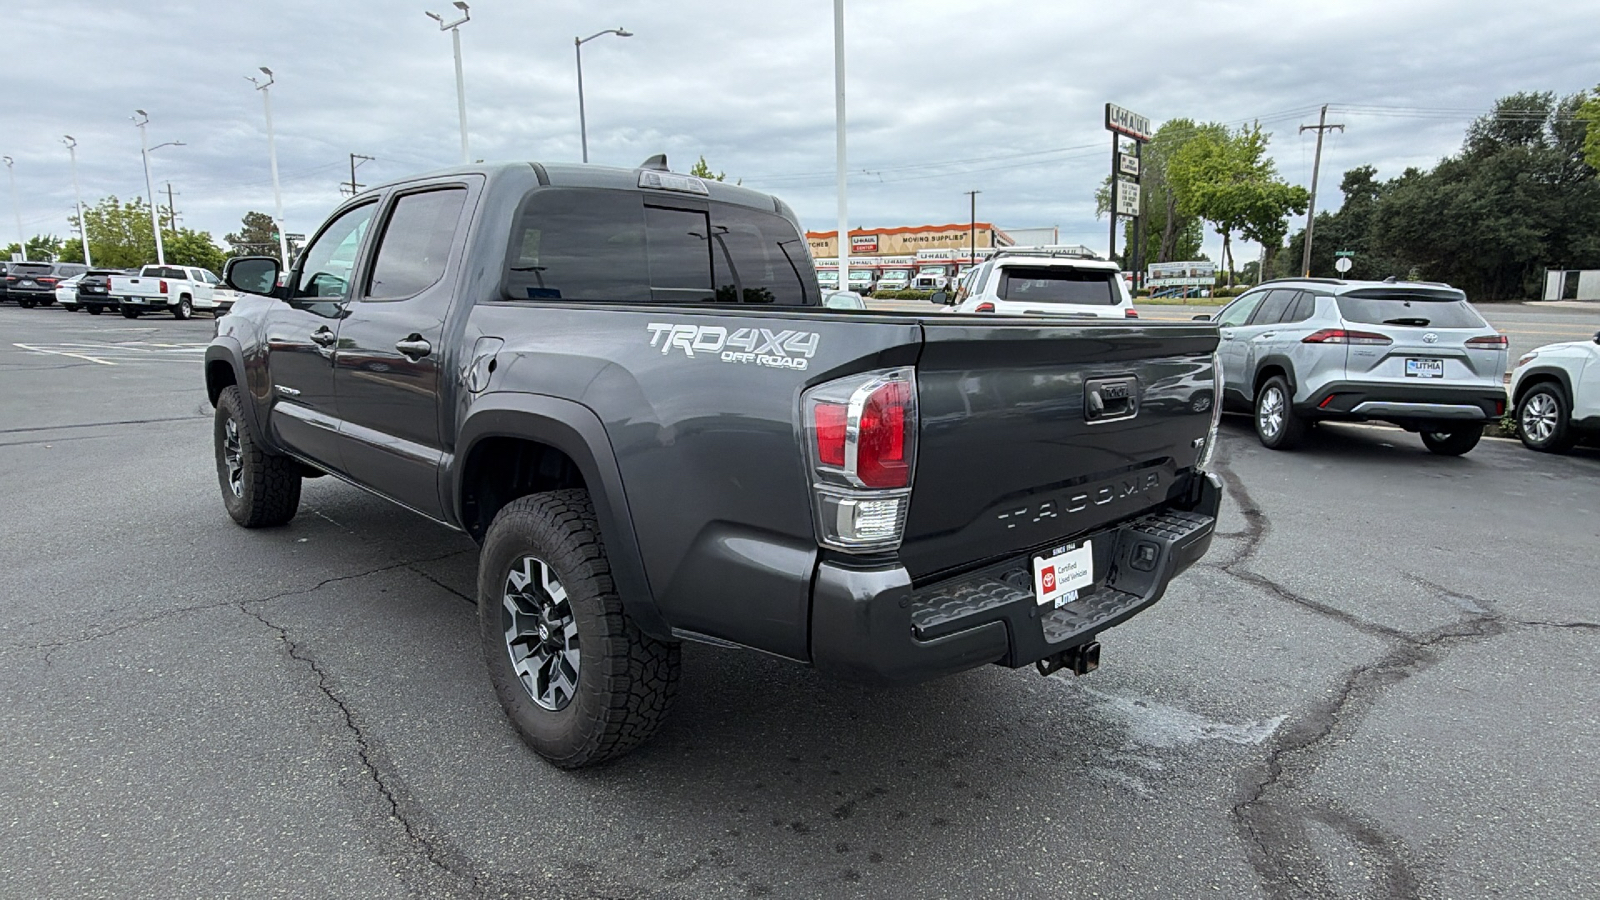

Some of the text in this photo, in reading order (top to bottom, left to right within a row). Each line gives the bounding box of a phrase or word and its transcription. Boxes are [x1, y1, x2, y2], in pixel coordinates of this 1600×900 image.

[931, 234, 964, 242] SUPPLIES
[720, 351, 809, 371] OFF ROAD
[1415, 362, 1441, 371] LITHIA
[997, 471, 1160, 528] TACOMA
[1053, 546, 1066, 556] SINCE
[1058, 562, 1077, 574] Certified
[1059, 570, 1087, 585] Used Vehicles
